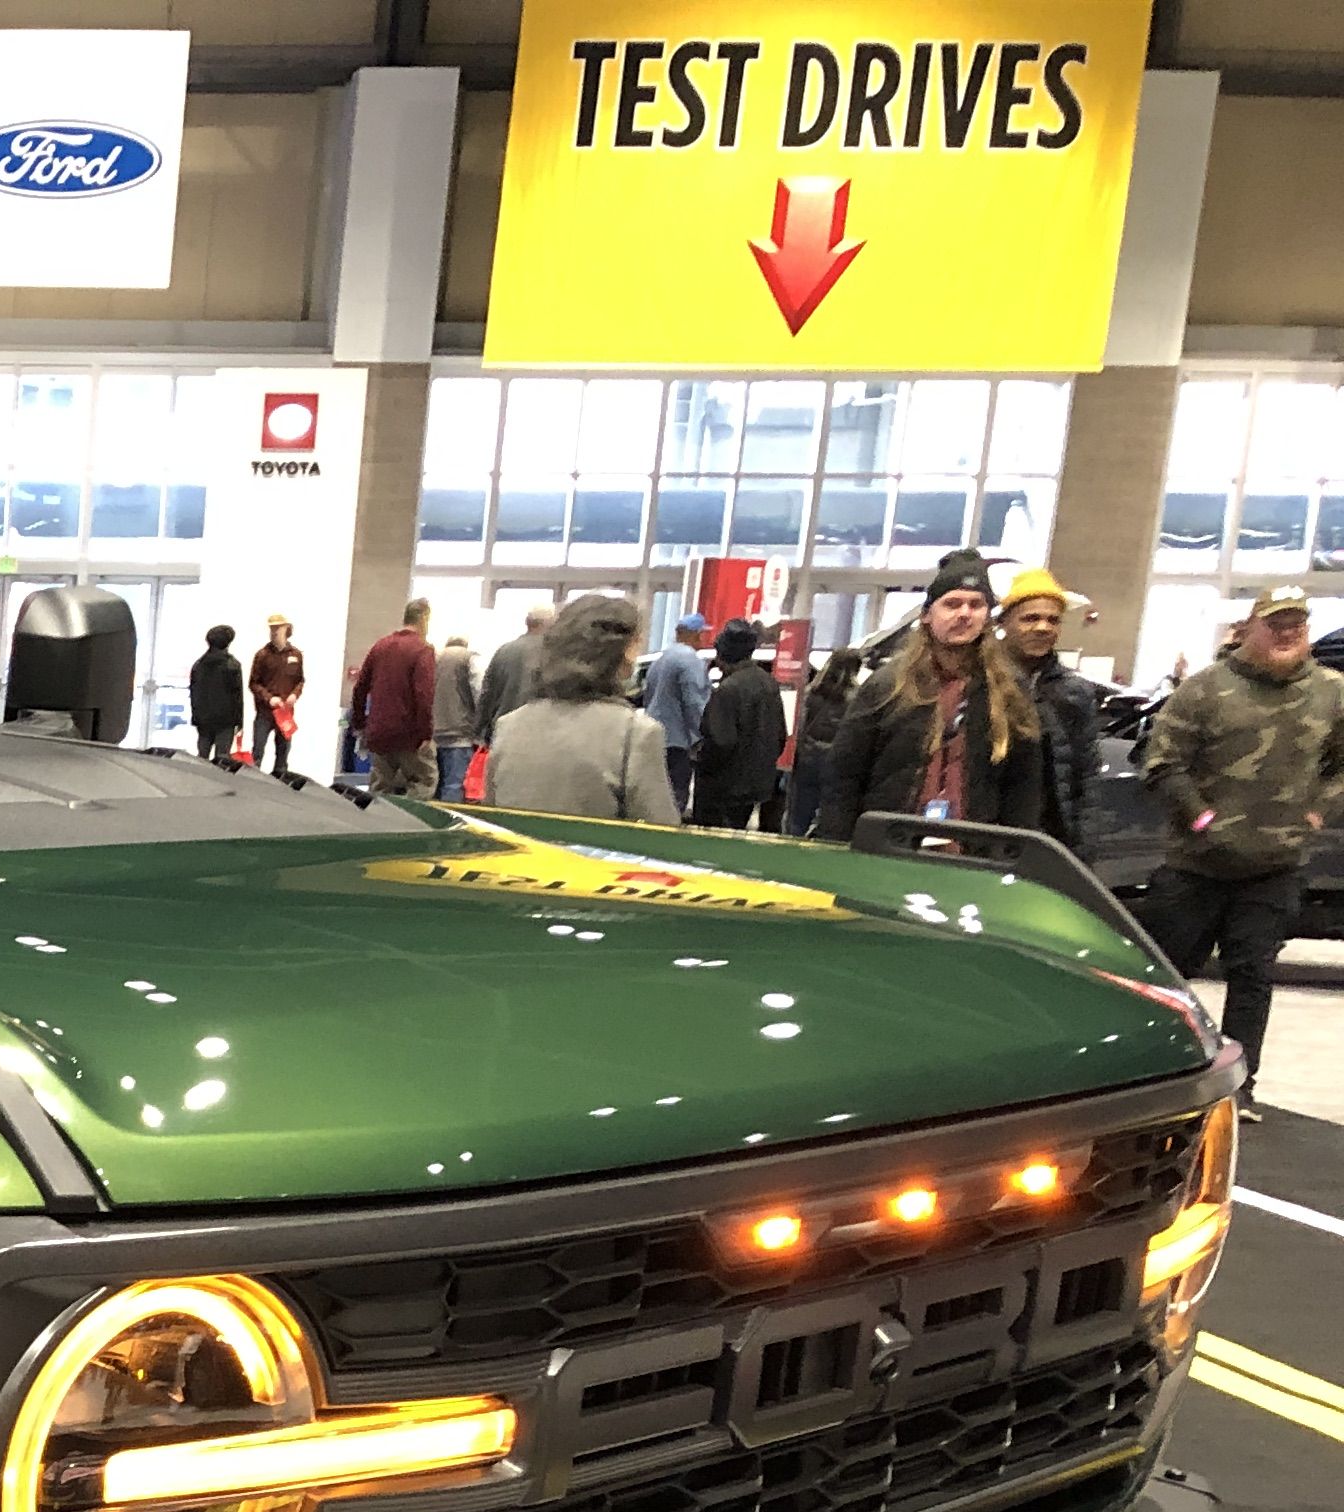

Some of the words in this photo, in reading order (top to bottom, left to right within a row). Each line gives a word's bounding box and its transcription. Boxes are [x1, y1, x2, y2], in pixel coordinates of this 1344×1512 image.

[572, 41, 760, 148] TEST
[781, 42, 1087, 149] DRIVES
[251, 461, 320, 478] TOYOTA
[544, 1240, 1143, 1490] FORD
